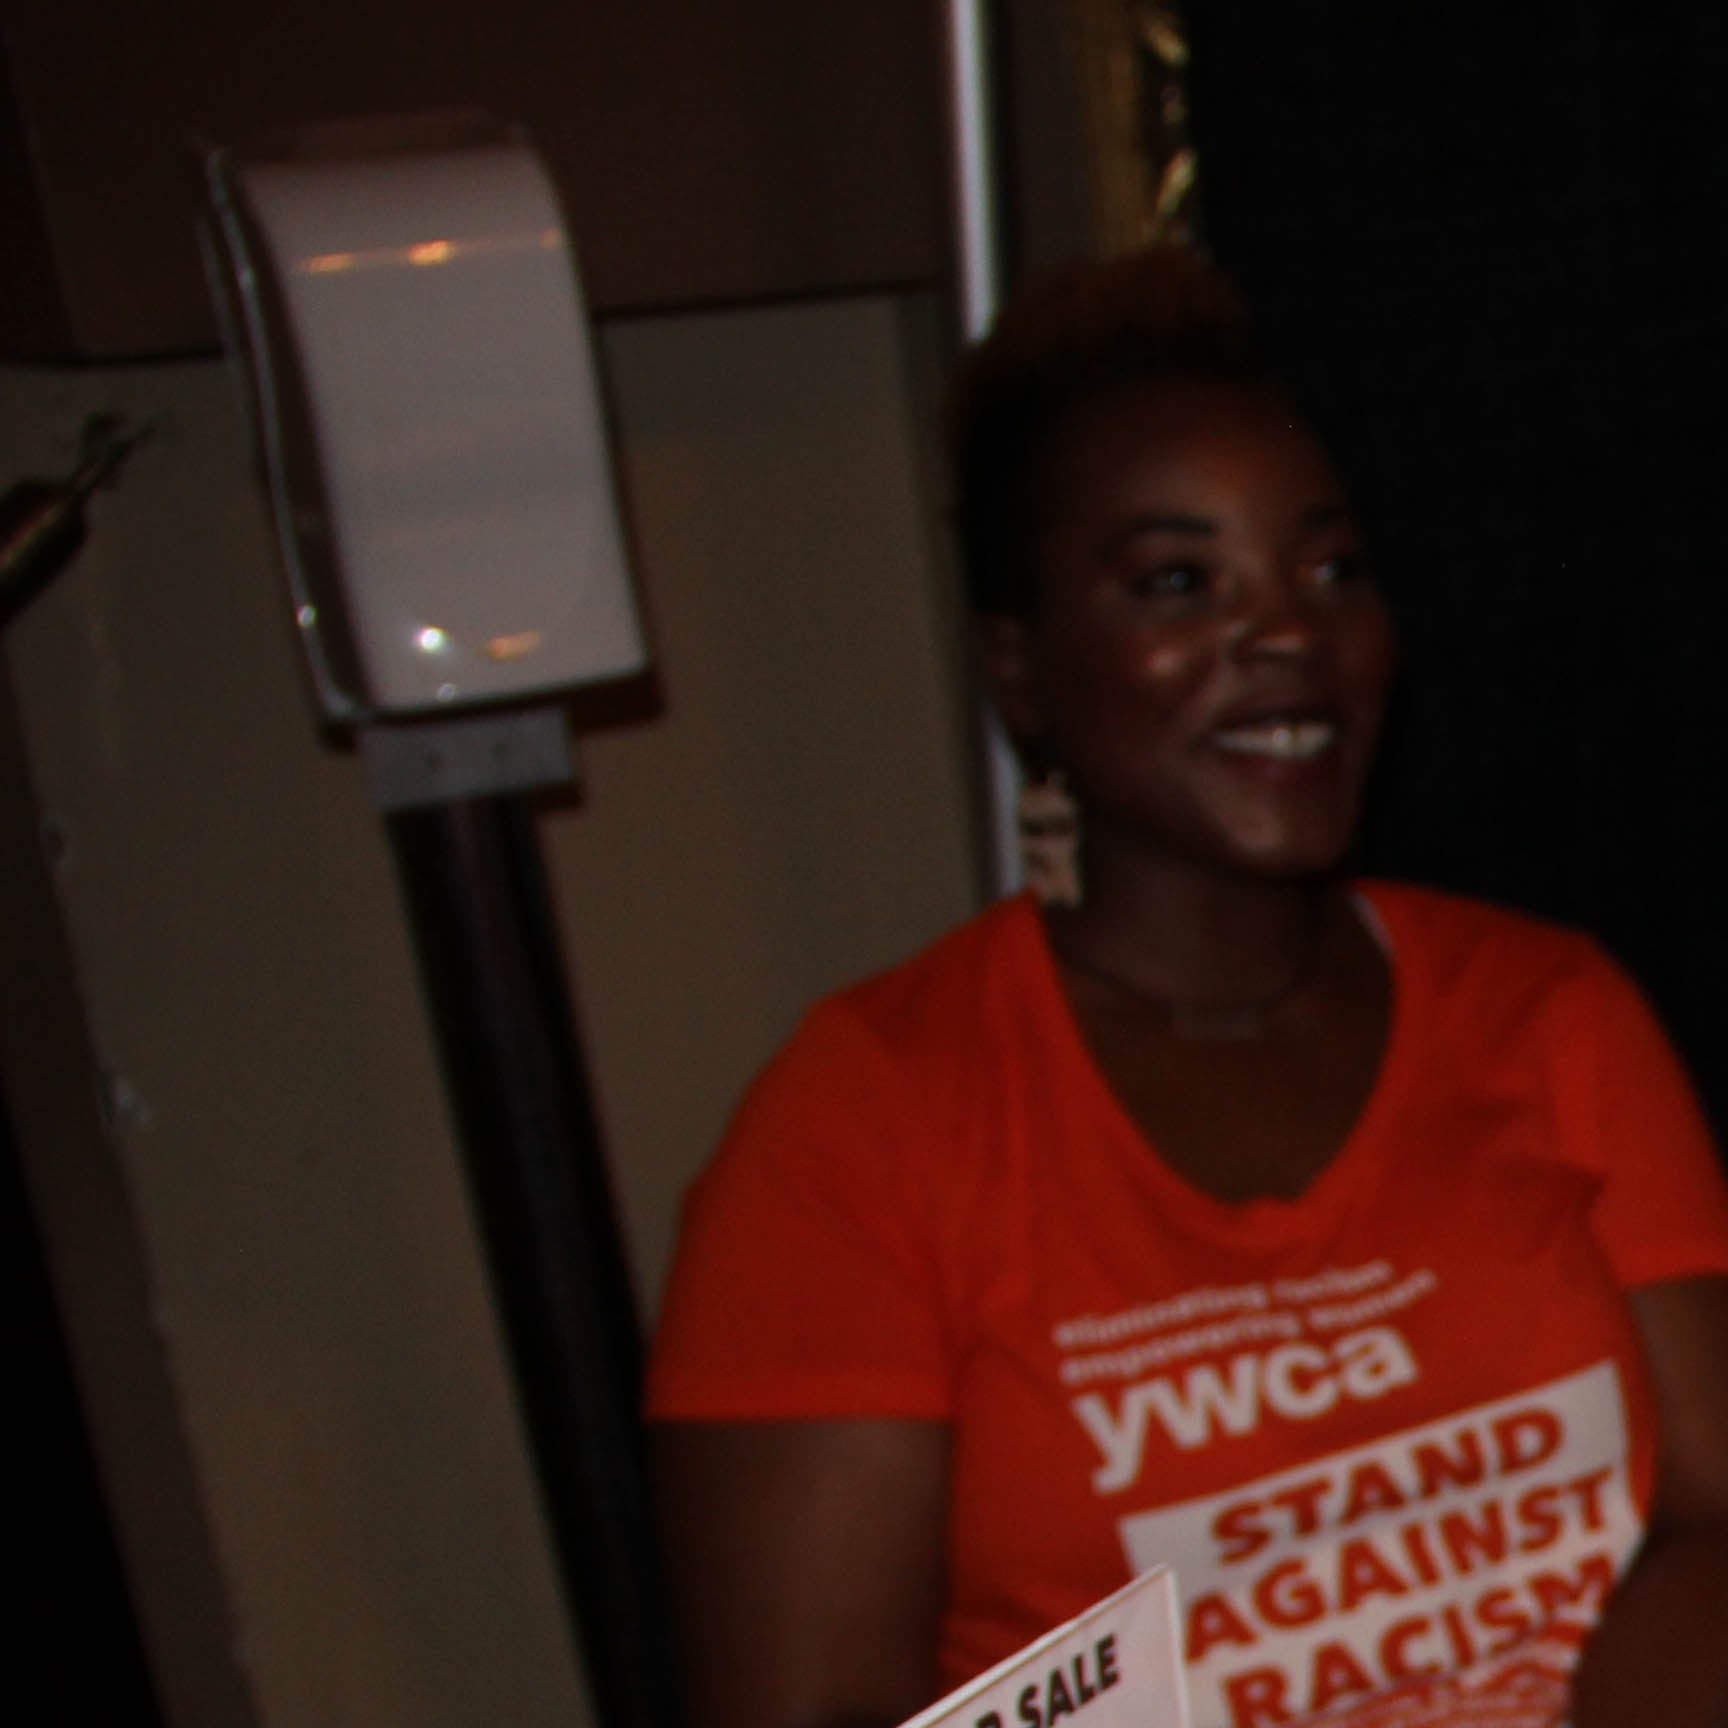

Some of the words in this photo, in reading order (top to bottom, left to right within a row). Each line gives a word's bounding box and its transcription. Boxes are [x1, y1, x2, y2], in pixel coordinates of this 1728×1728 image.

[1073, 1326, 1419, 1496] ywca
[1210, 1408, 1566, 1565] STAND
[1186, 1467, 1615, 1667] AGAINST
